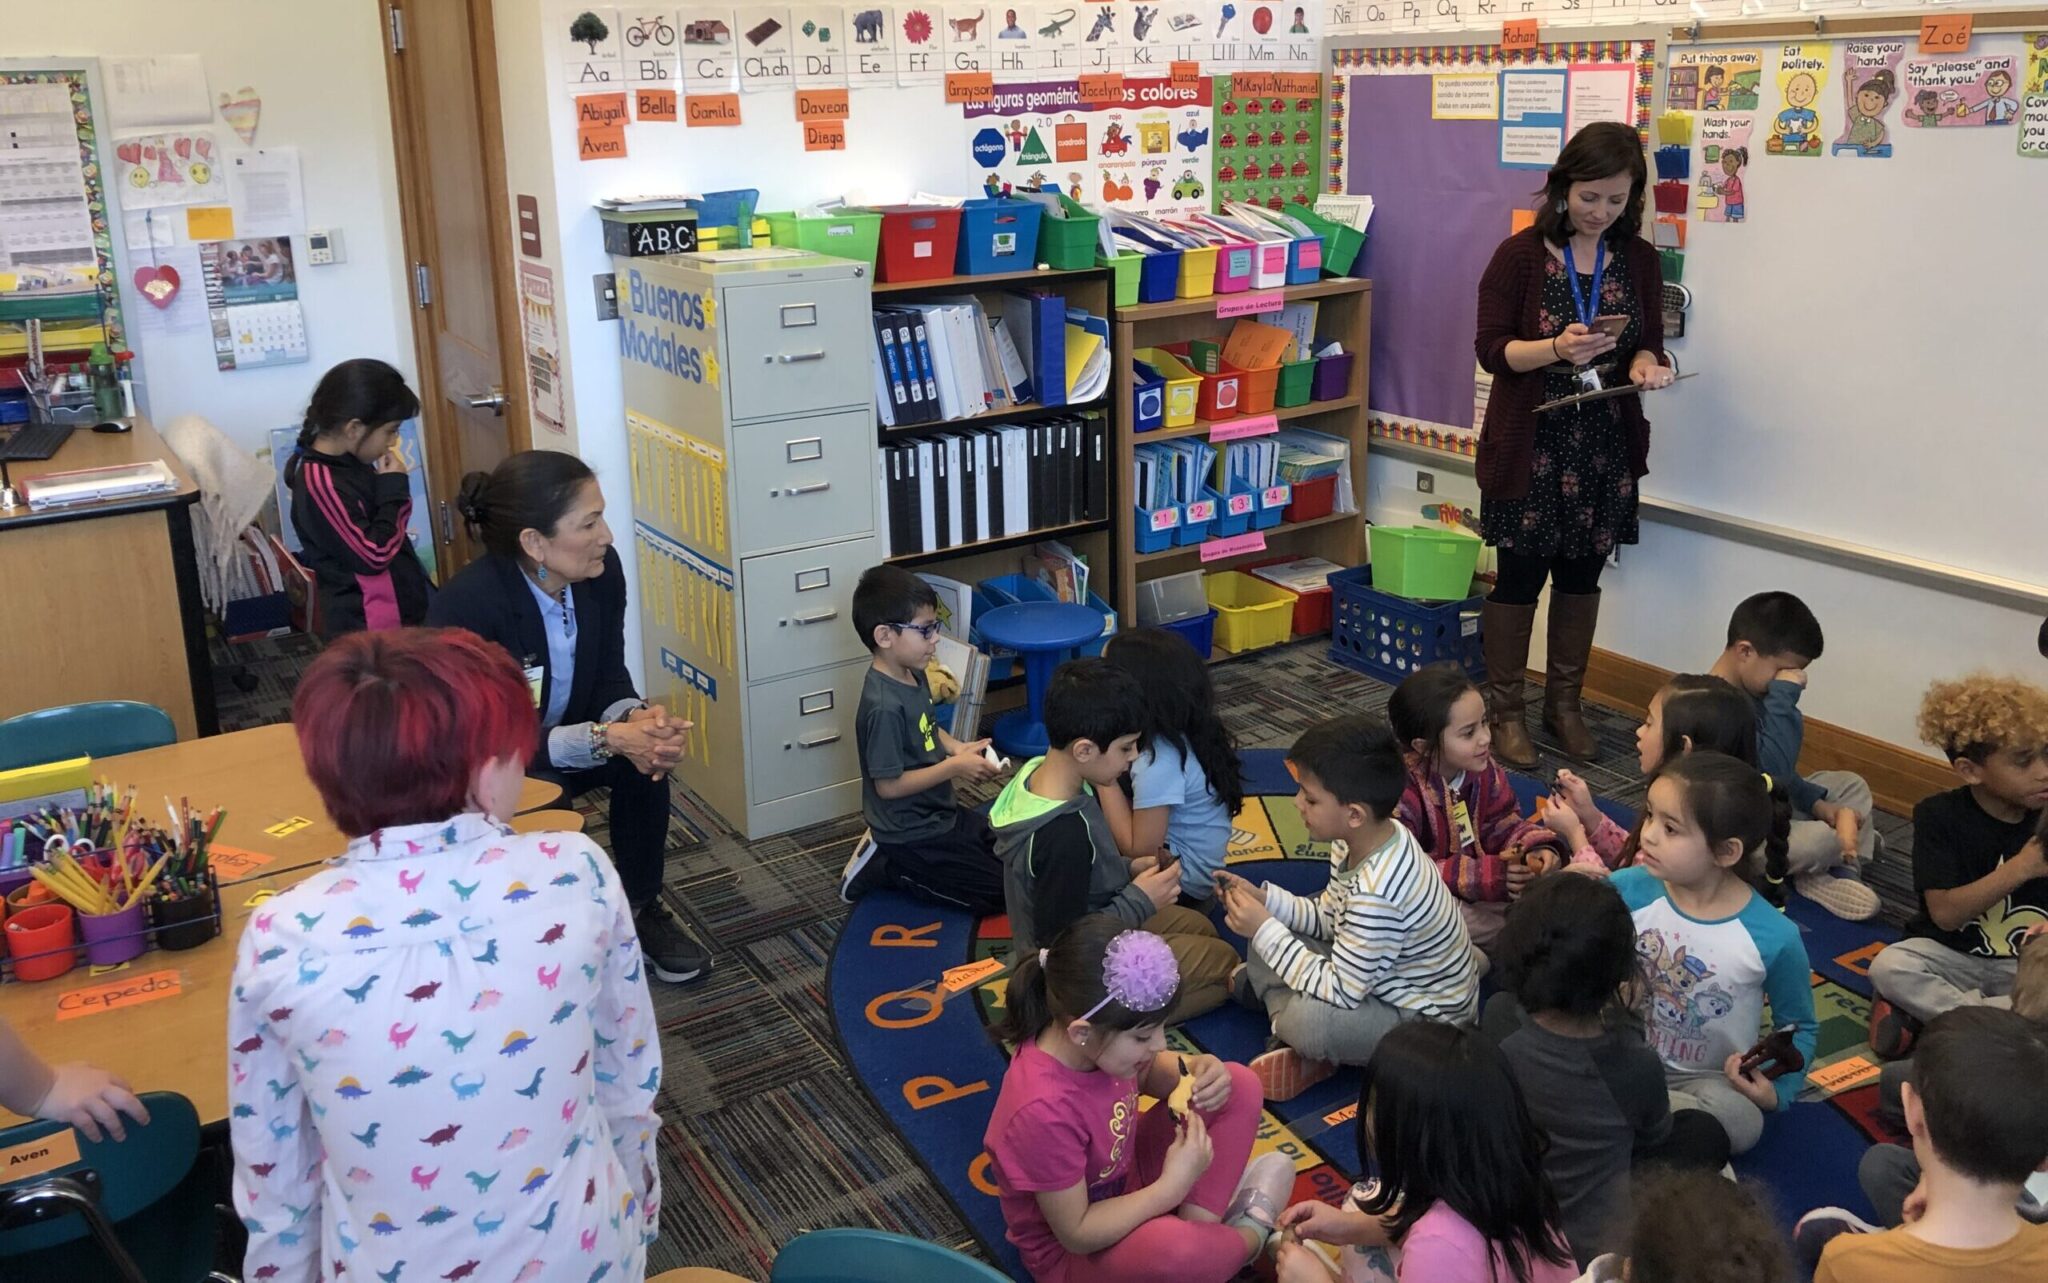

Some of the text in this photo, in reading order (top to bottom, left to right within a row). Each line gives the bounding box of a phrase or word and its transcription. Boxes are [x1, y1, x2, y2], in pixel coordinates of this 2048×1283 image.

[1402, 1, 1420, 26] Pp
[1502, 27, 1536, 44] Rohan
[1924, 25, 1967, 46] Zoé
[1134, 47, 1153, 64] Kk
[1249, 44, 1274, 60] Mm
[1289, 44, 1308, 61] Nn
[1783, 46, 1801, 57] Eat
[1846, 43, 1903, 56] Raise your
[807, 55, 831, 75] Dd
[859, 54, 881, 73] Ee
[909, 53, 929, 72] Ff
[1001, 52, 1023, 70] Hh
[1680, 53, 1759, 65] Put things away.
[1781, 58, 1825, 71] politely.
[1856, 56, 1887, 66] hand.
[1908, 63, 1928, 76] Say
[1984, 58, 2011, 70] and
[580, 62, 610, 83] Aa
[640, 59, 668, 80] Bb
[697, 58, 724, 79] Cc
[1172, 68, 1199, 83] Lucas
[948, 80, 993, 100] Grayson
[1081, 81, 1121, 101] Jocelyn
[1140, 82, 1198, 100] colores
[1272, 78, 1318, 94] Nathaniel
[640, 96, 677, 114] Bella
[800, 97, 849, 115] Daveon
[1026, 85, 1079, 111] geométric
[580, 100, 626, 126] Abigail
[1108, 113, 1122, 121] rojo
[1703, 117, 1751, 130] Wash your
[808, 127, 844, 150] Diego
[1702, 128, 1731, 139] hands.
[2023, 127, 2045, 138] you
[581, 136, 620, 154] Aven
[974, 144, 1004, 153] octágono
[1057, 138, 1086, 147] cuadrado
[2021, 141, 2035, 150] or
[1021, 152, 1048, 162] triángulo
[1141, 158, 1167, 167] púrpura
[1181, 156, 1199, 164] verde
[629, 269, 706, 332] Buenos
[1218, 305, 1244, 314] Grupos
[1255, 299, 1282, 309] Lectura
[618, 315, 702, 385] Modales
[1271, 489, 1278, 501] 4
[1196, 505, 1203, 518] 2
[1237, 498, 1245, 510] 3
[1163, 513, 1168, 524] 1
[1227, 843, 1274, 858] lanco
[869, 921, 943, 947] R
[57, 976, 180, 1011] Cepeda
[902, 1075, 991, 1110] P
[9, 1147, 50, 1165] Aven
